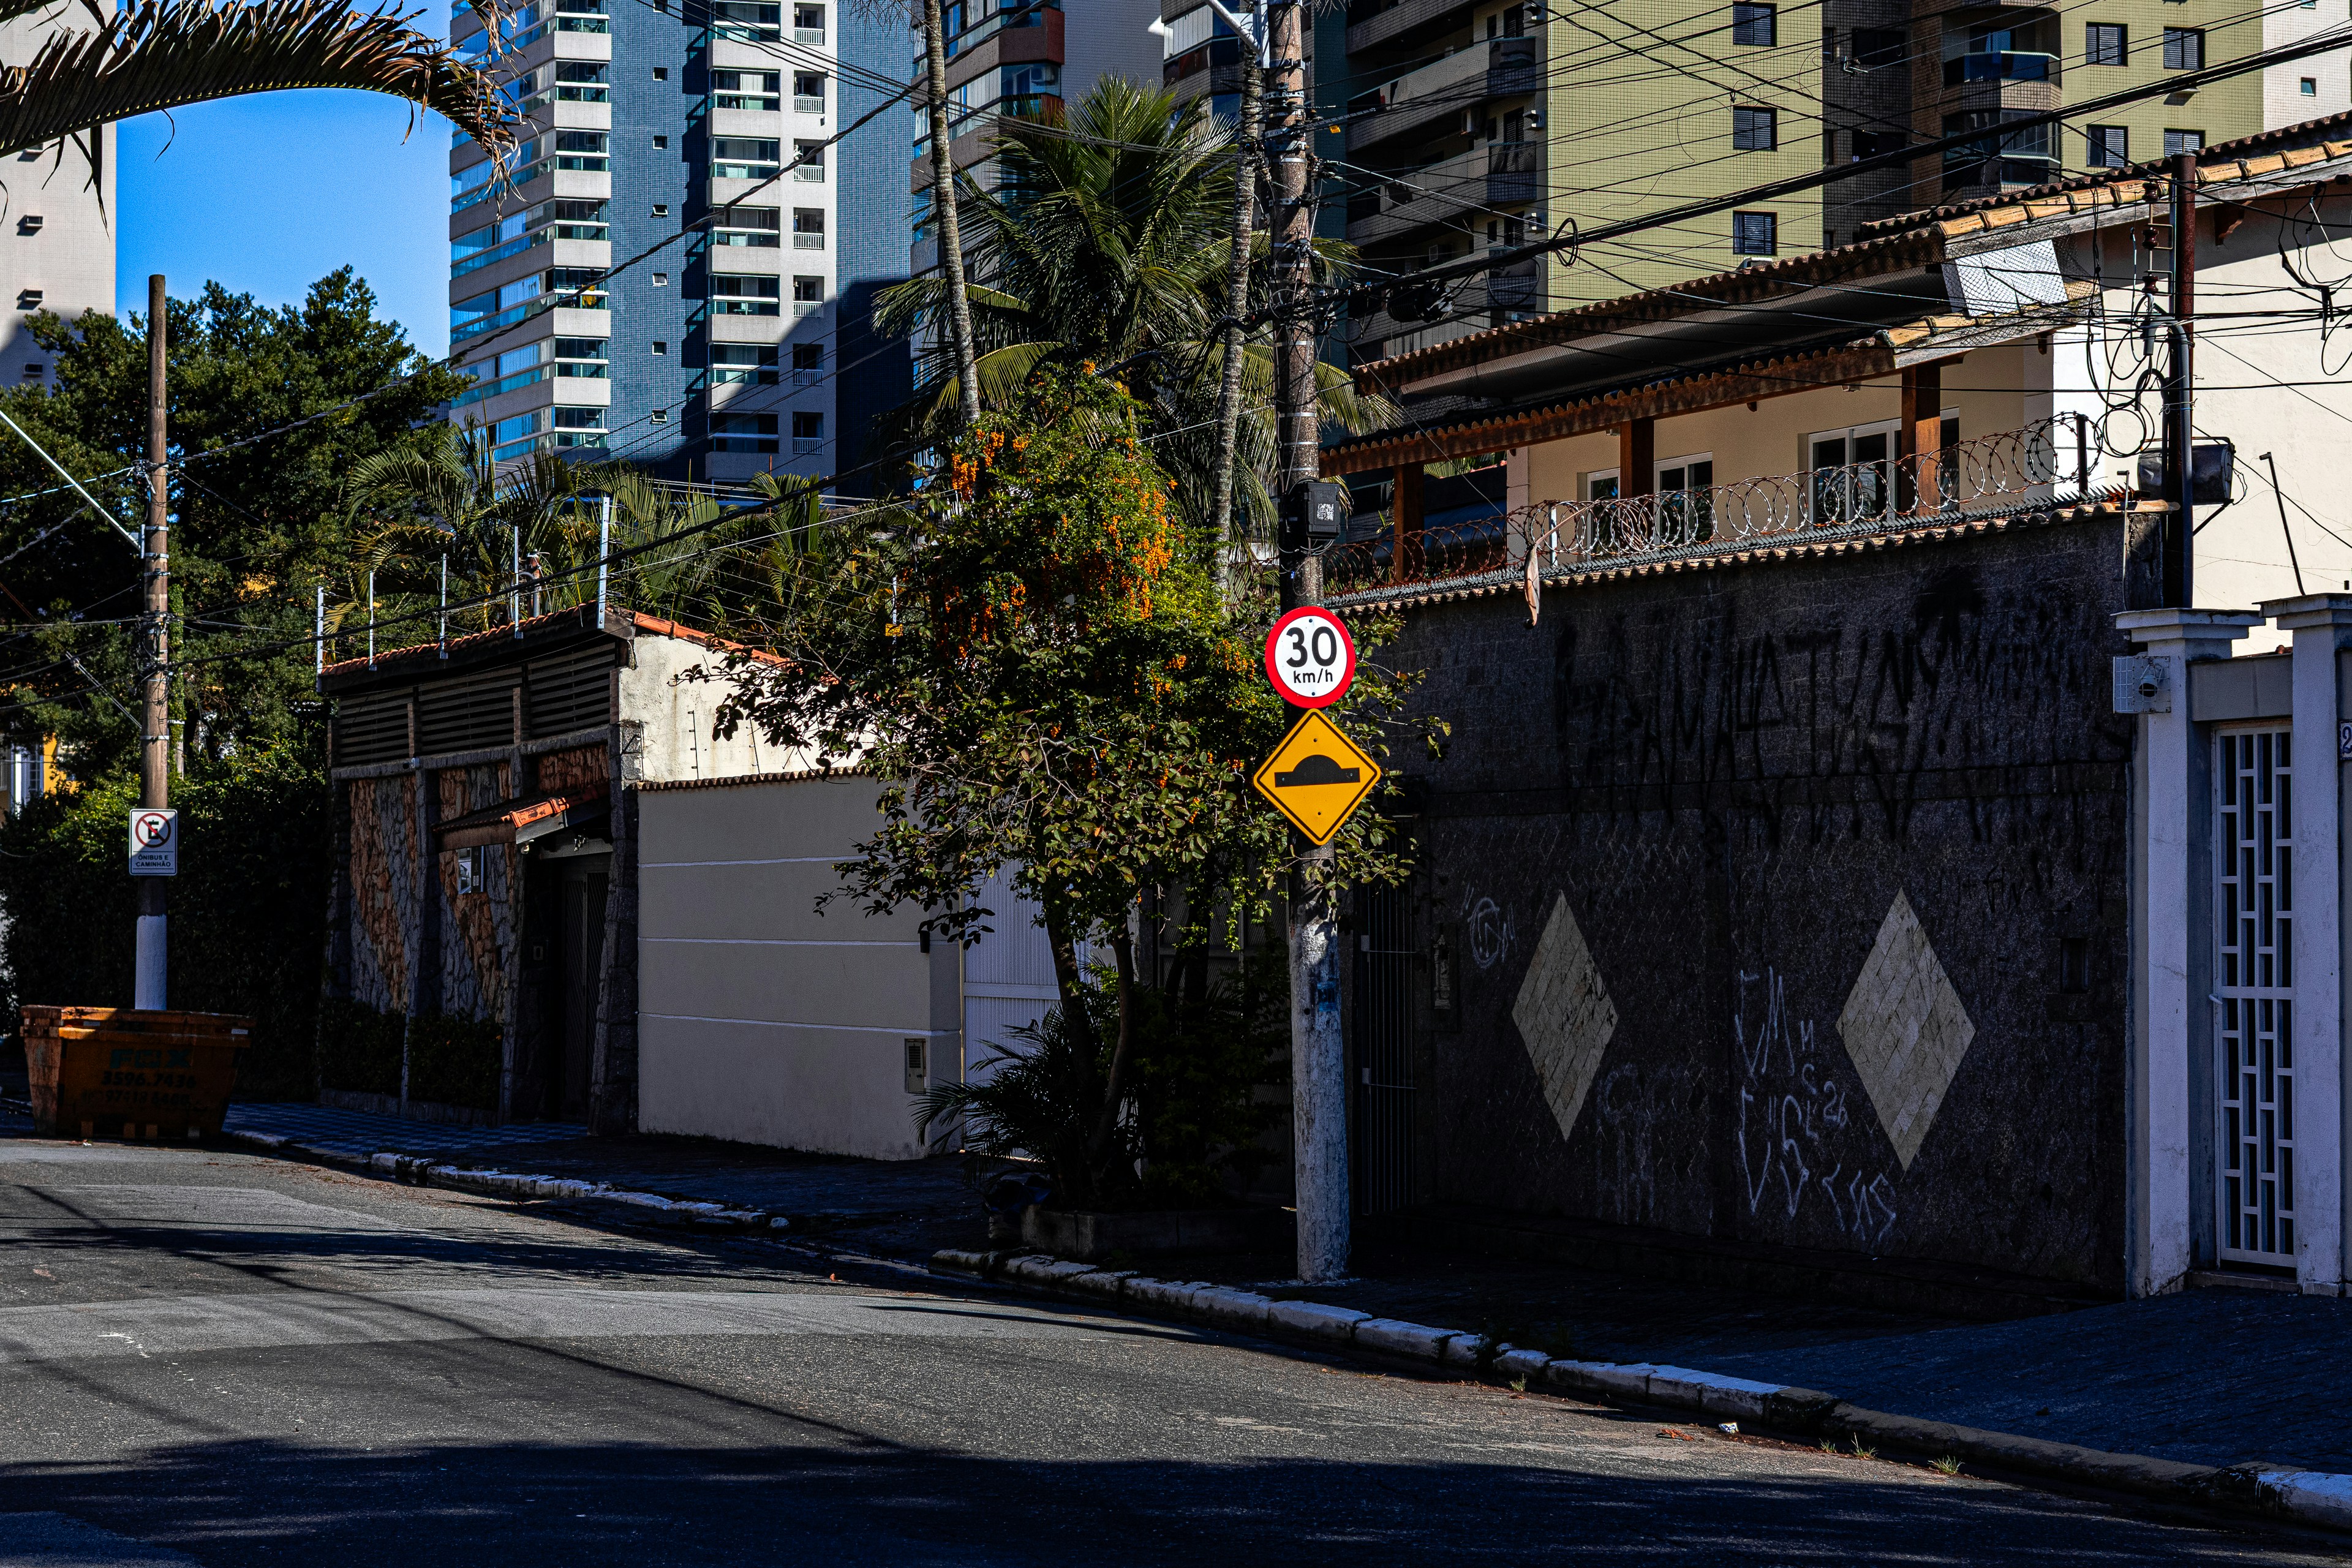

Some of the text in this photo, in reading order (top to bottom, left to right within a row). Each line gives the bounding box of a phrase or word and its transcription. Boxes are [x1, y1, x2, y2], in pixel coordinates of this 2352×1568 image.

[1286, 626, 1337, 668] 30
[1293, 668, 1333, 684] km/h
[148, 821, 159, 839] E
[110, 1049, 190, 1069] FOX
